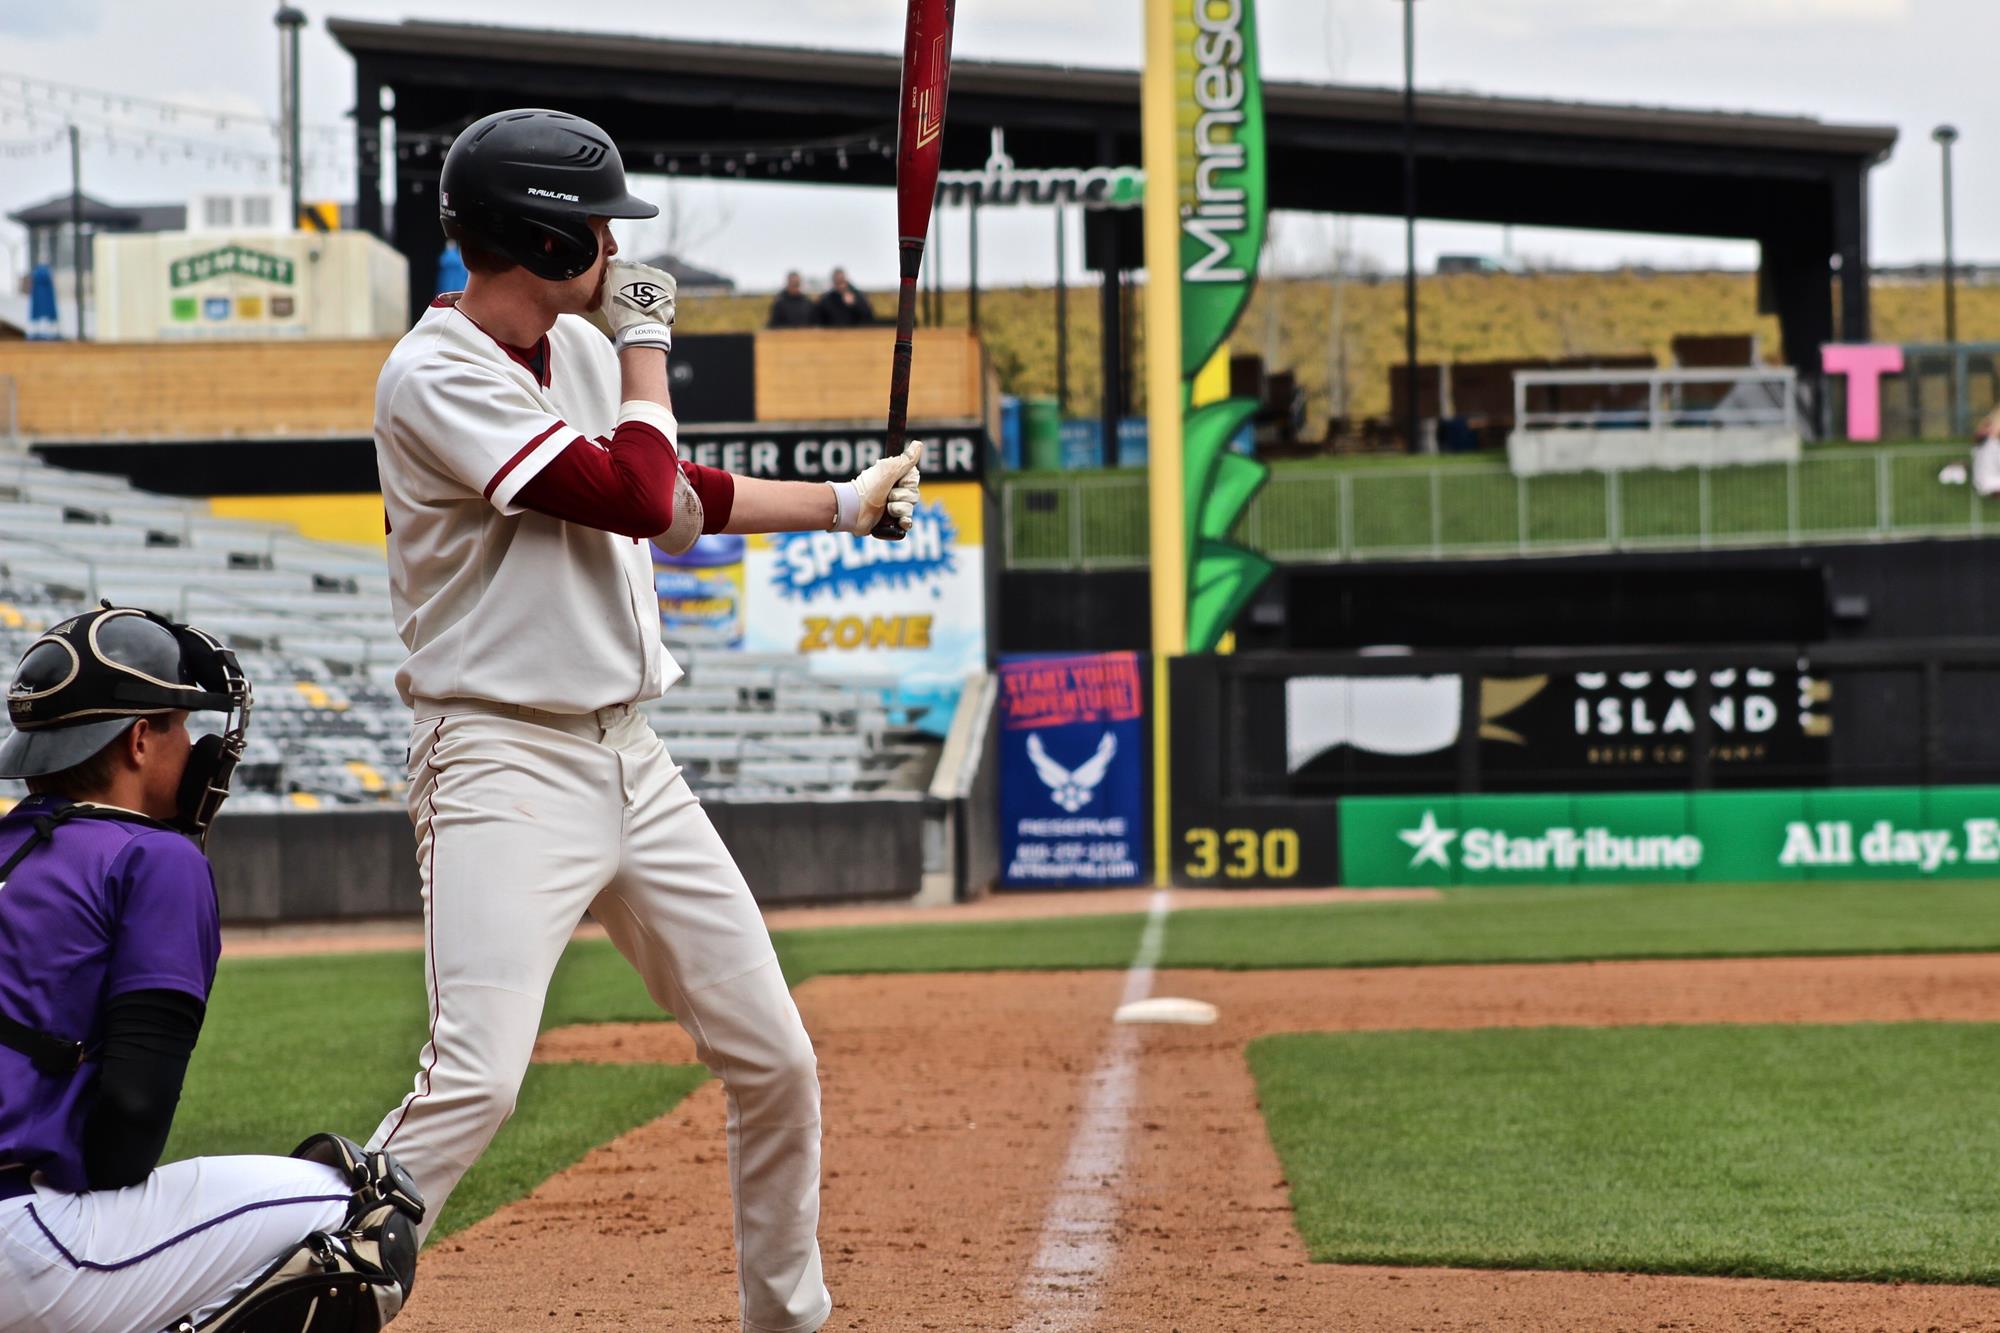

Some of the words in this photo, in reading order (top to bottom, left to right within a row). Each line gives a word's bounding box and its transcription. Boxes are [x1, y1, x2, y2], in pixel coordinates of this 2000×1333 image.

[528, 188, 579, 202] RAWLINGS
[1822, 344, 1903, 440] T
[794, 436, 974, 475] CORER
[801, 614, 933, 650] ZONE
[1184, 827, 1300, 878] 330
[1461, 826, 1703, 869] StarTribune
[1778, 819, 1854, 866] All
[1859, 818, 1958, 873] day.
